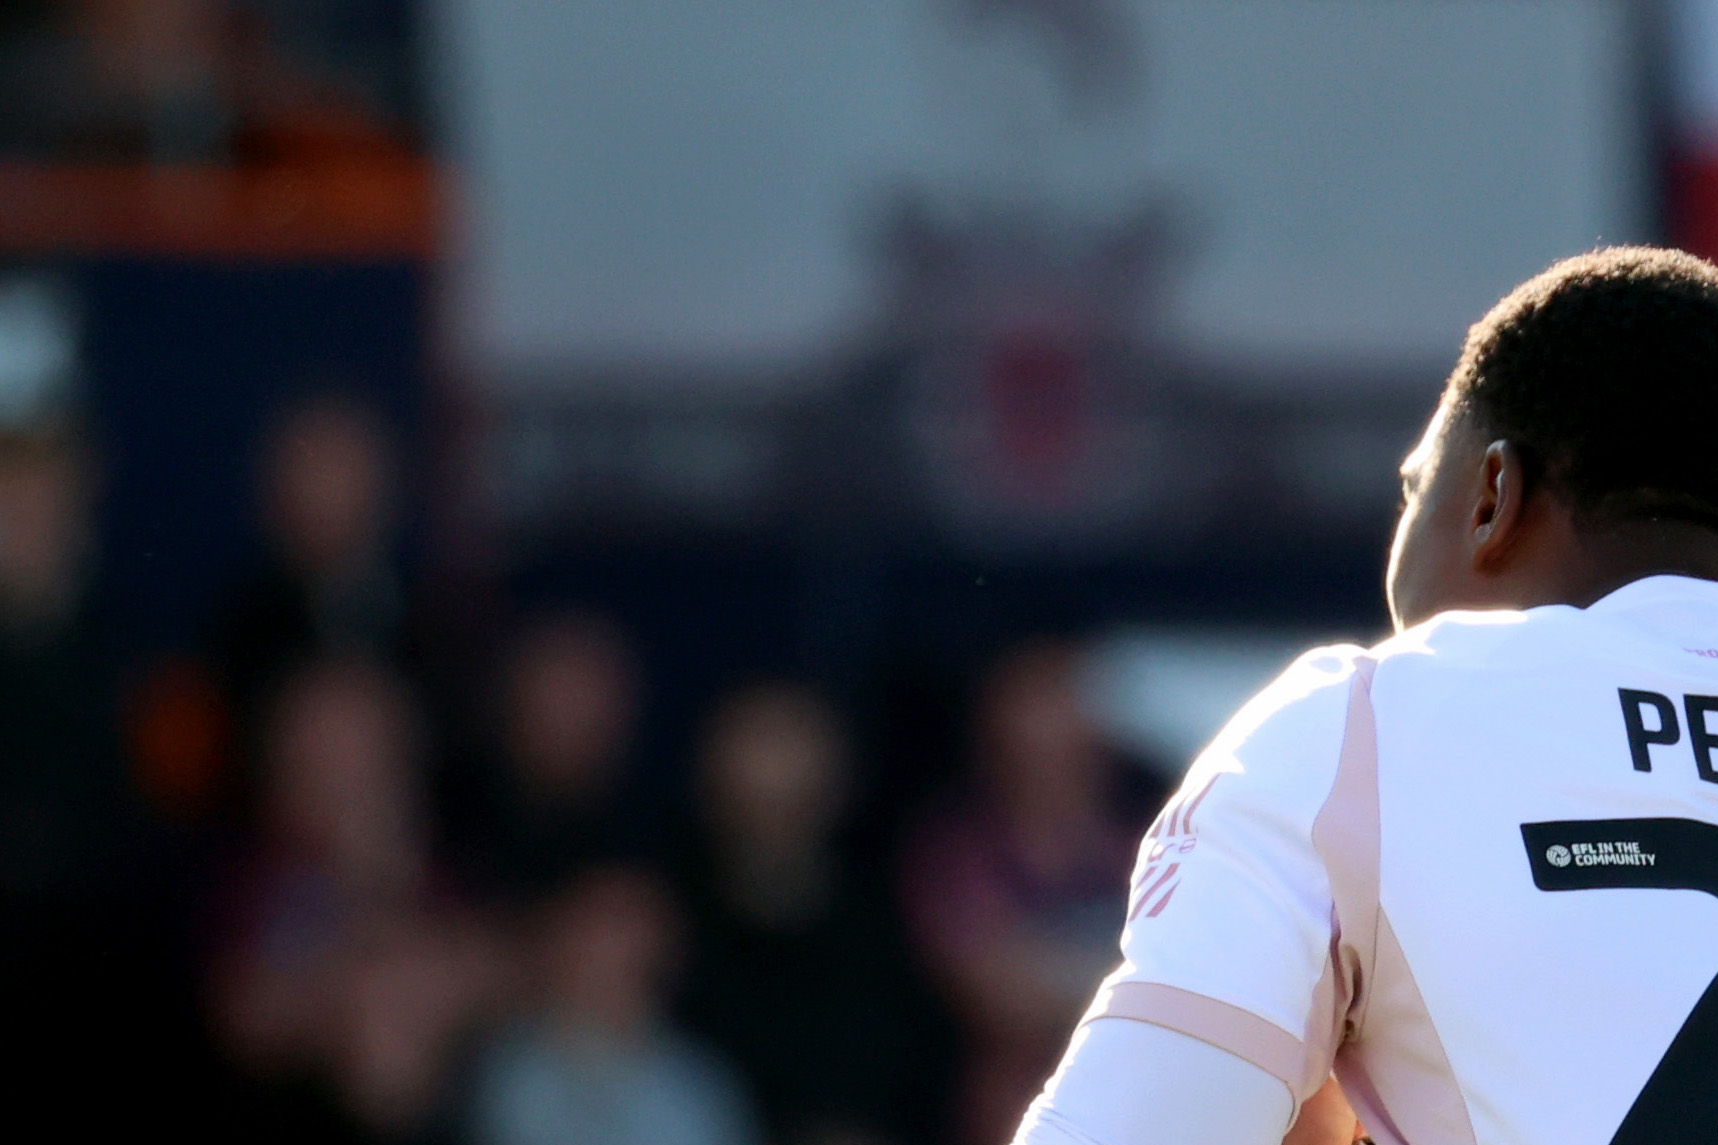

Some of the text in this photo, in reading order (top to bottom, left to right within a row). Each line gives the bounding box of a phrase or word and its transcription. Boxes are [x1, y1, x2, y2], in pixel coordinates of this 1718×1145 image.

[1571, 842, 1641, 855] EFL IN THE
[1574, 853, 1656, 867] COMMUNITY
